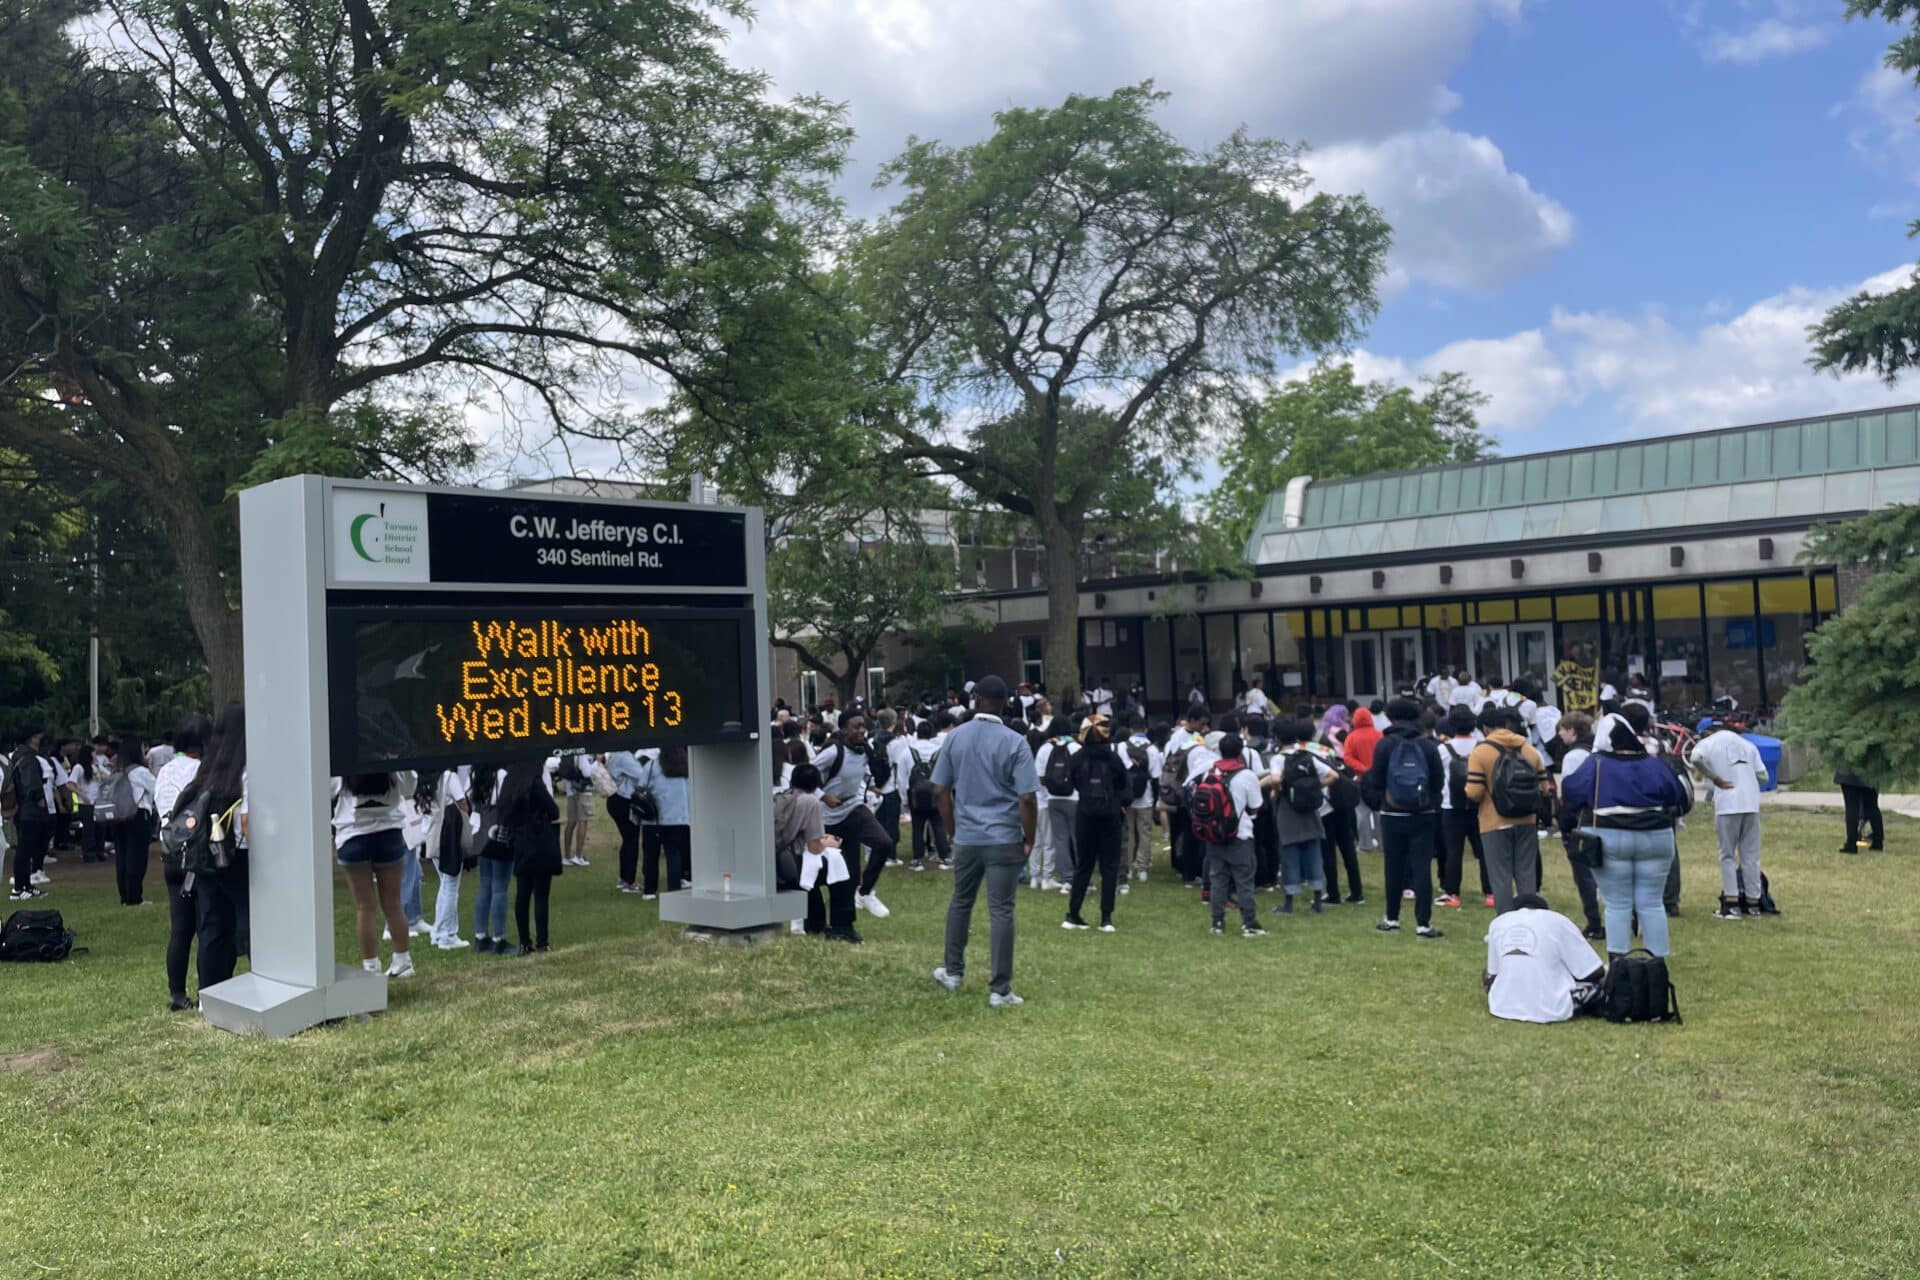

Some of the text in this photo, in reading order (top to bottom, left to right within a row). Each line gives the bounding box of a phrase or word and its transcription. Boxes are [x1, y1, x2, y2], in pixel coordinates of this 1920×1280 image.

[384, 521, 418, 531] Toronto
[510, 515, 684, 547] C.W. Jefferys C.I.
[384, 533, 416, 542] District
[384, 544, 413, 553] School
[537, 548, 664, 568] 340 Sentinel Rd.
[385, 555, 411, 564] Board
[472, 619, 650, 659] Walk with
[462, 658, 660, 700] Excellence
[436, 690, 682, 742] Wed June 13
